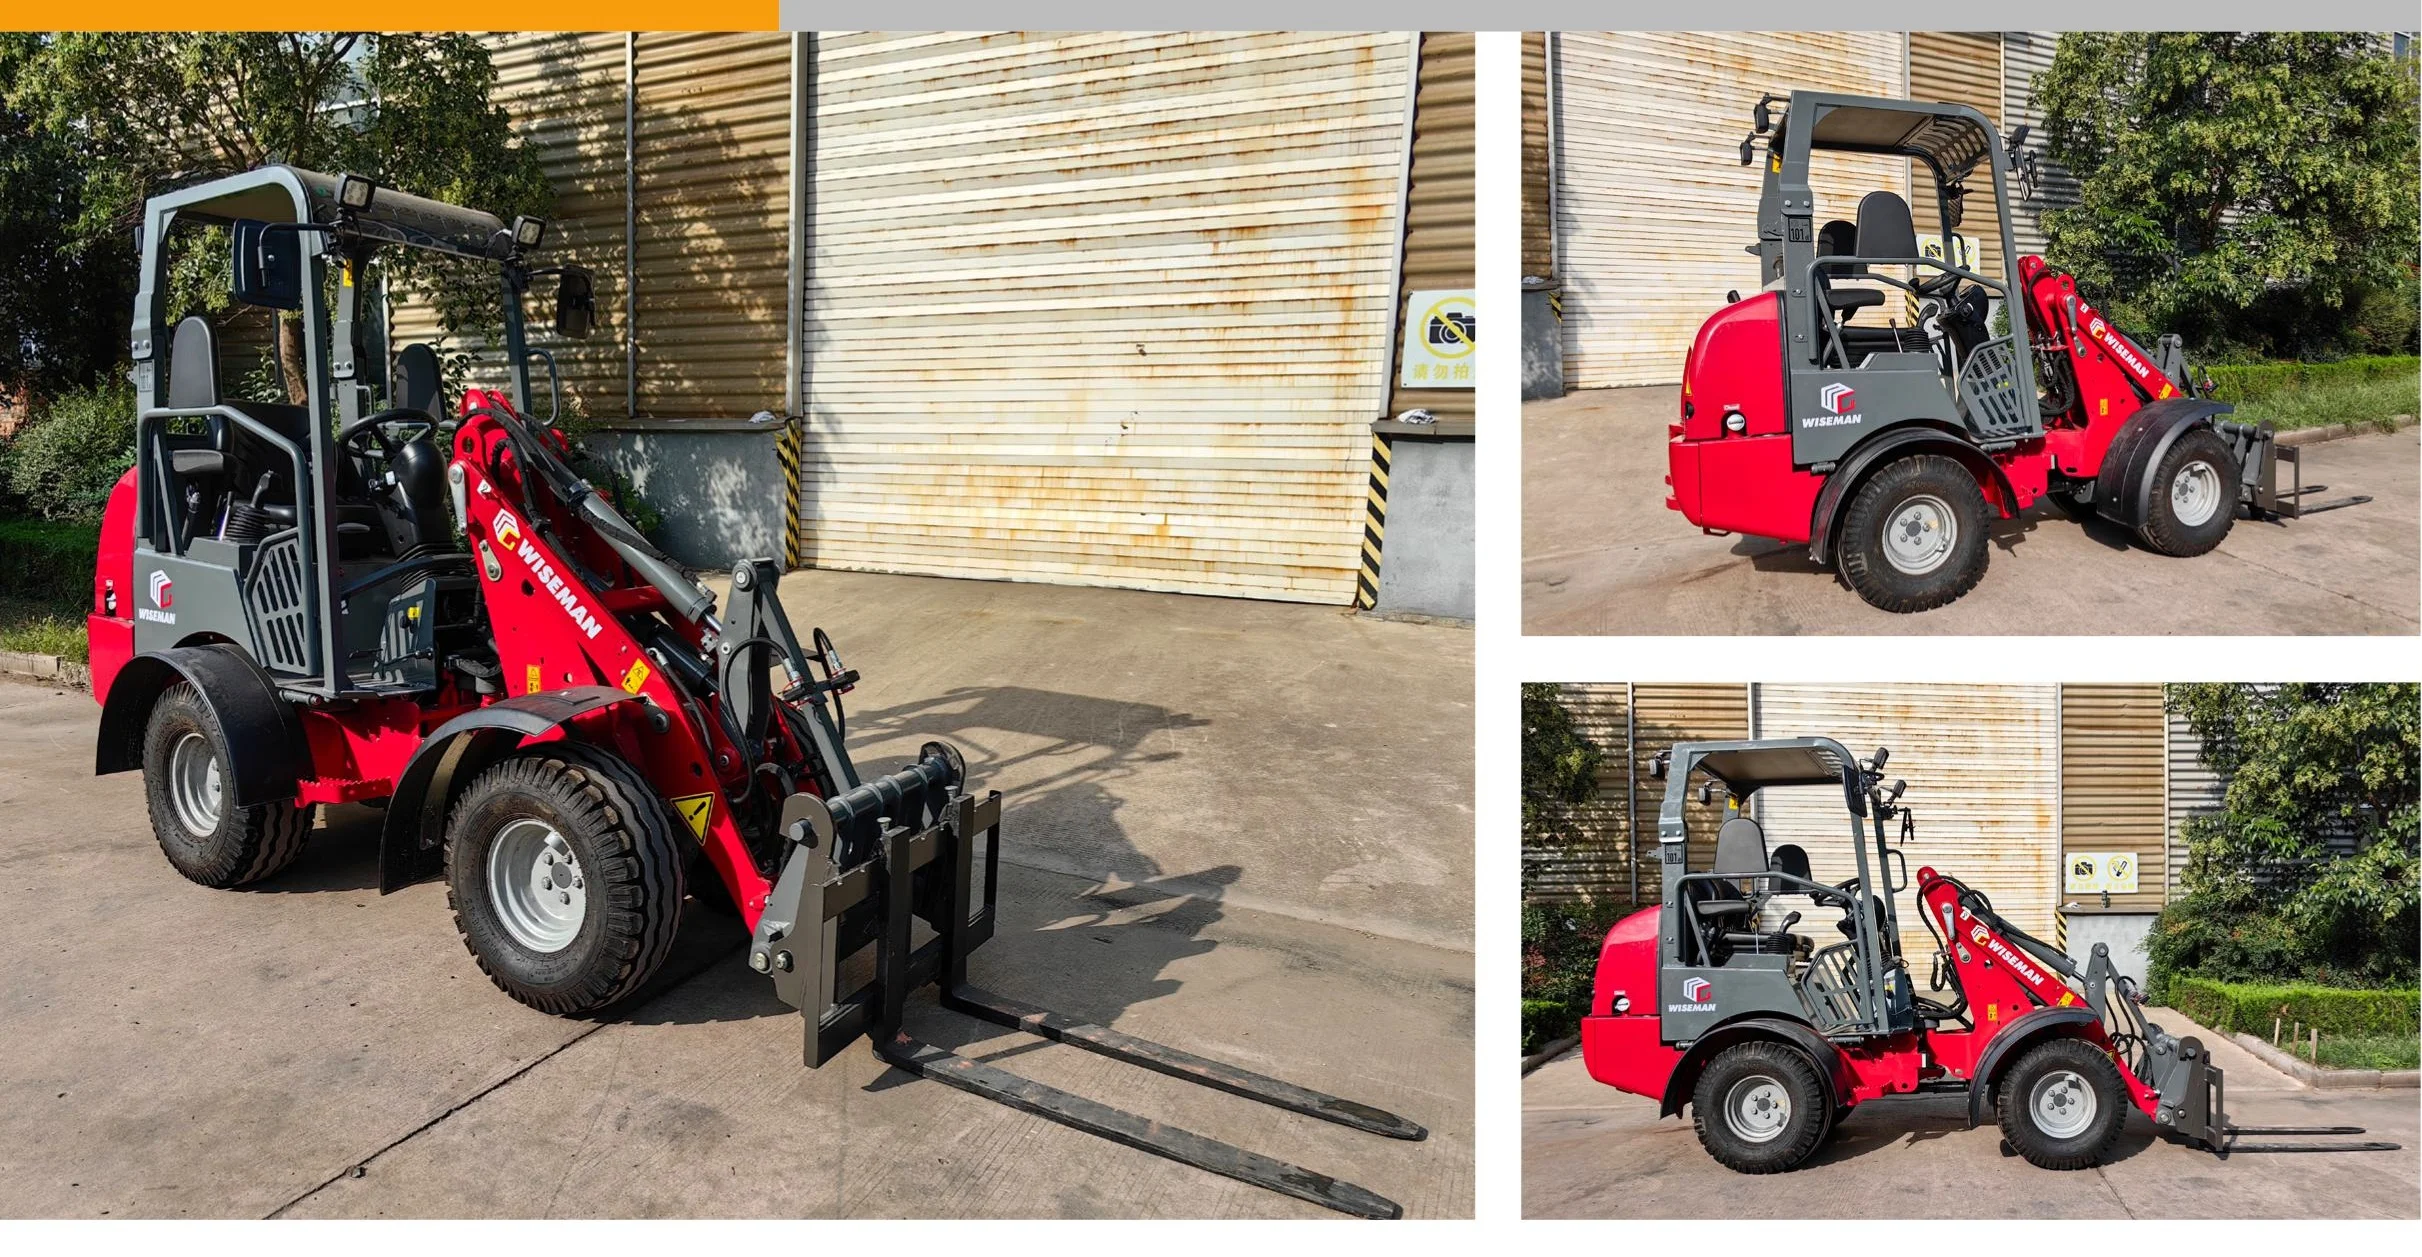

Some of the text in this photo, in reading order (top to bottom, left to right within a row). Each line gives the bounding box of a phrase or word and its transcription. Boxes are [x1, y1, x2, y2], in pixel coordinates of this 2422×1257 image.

[1791, 227, 1804, 240] 101
[2104, 332, 2150, 378] WISEMAN
[1802, 414, 1862, 428] WISEMAN
[517, 538, 603, 640] WISEMAN
[138, 607, 176, 625] WISEMAN
[1987, 939, 2044, 986] WISEMAN
[1668, 1003, 1716, 1012] WISEMAN
